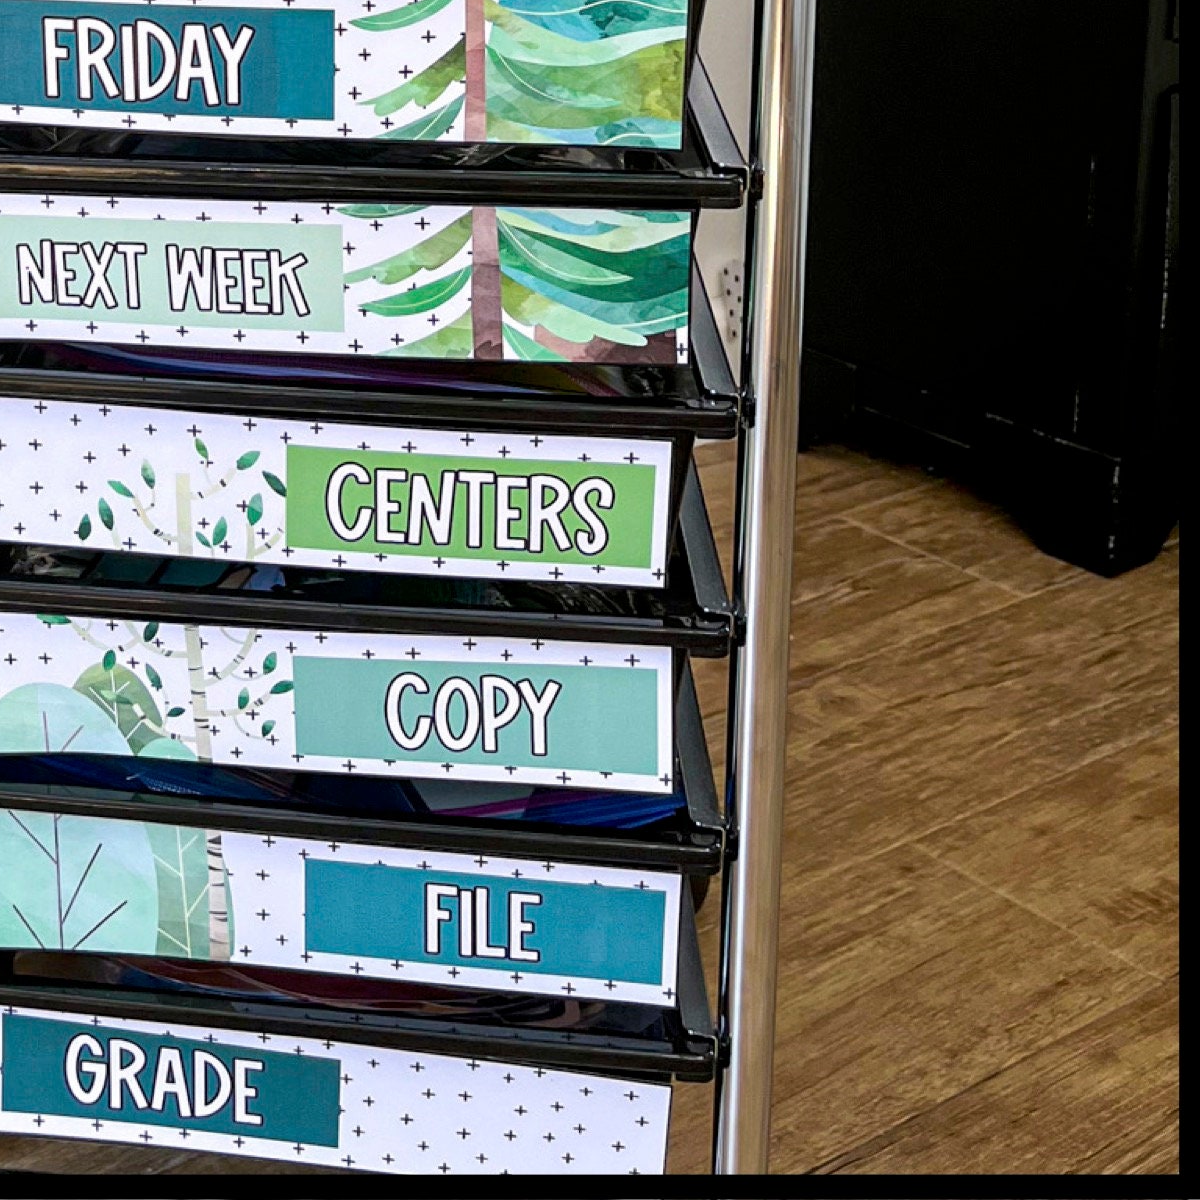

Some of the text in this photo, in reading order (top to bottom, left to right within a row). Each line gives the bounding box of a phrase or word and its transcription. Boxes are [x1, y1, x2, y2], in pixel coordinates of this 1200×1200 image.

[42, 16, 255, 107] FRIDAY
[16, 239, 311, 317] NEXT WEEK
[325, 461, 615, 556] CENTERS
[384, 671, 562, 756] COPY
[424, 881, 543, 963] FILE
[64, 1032, 265, 1128] GRADE
